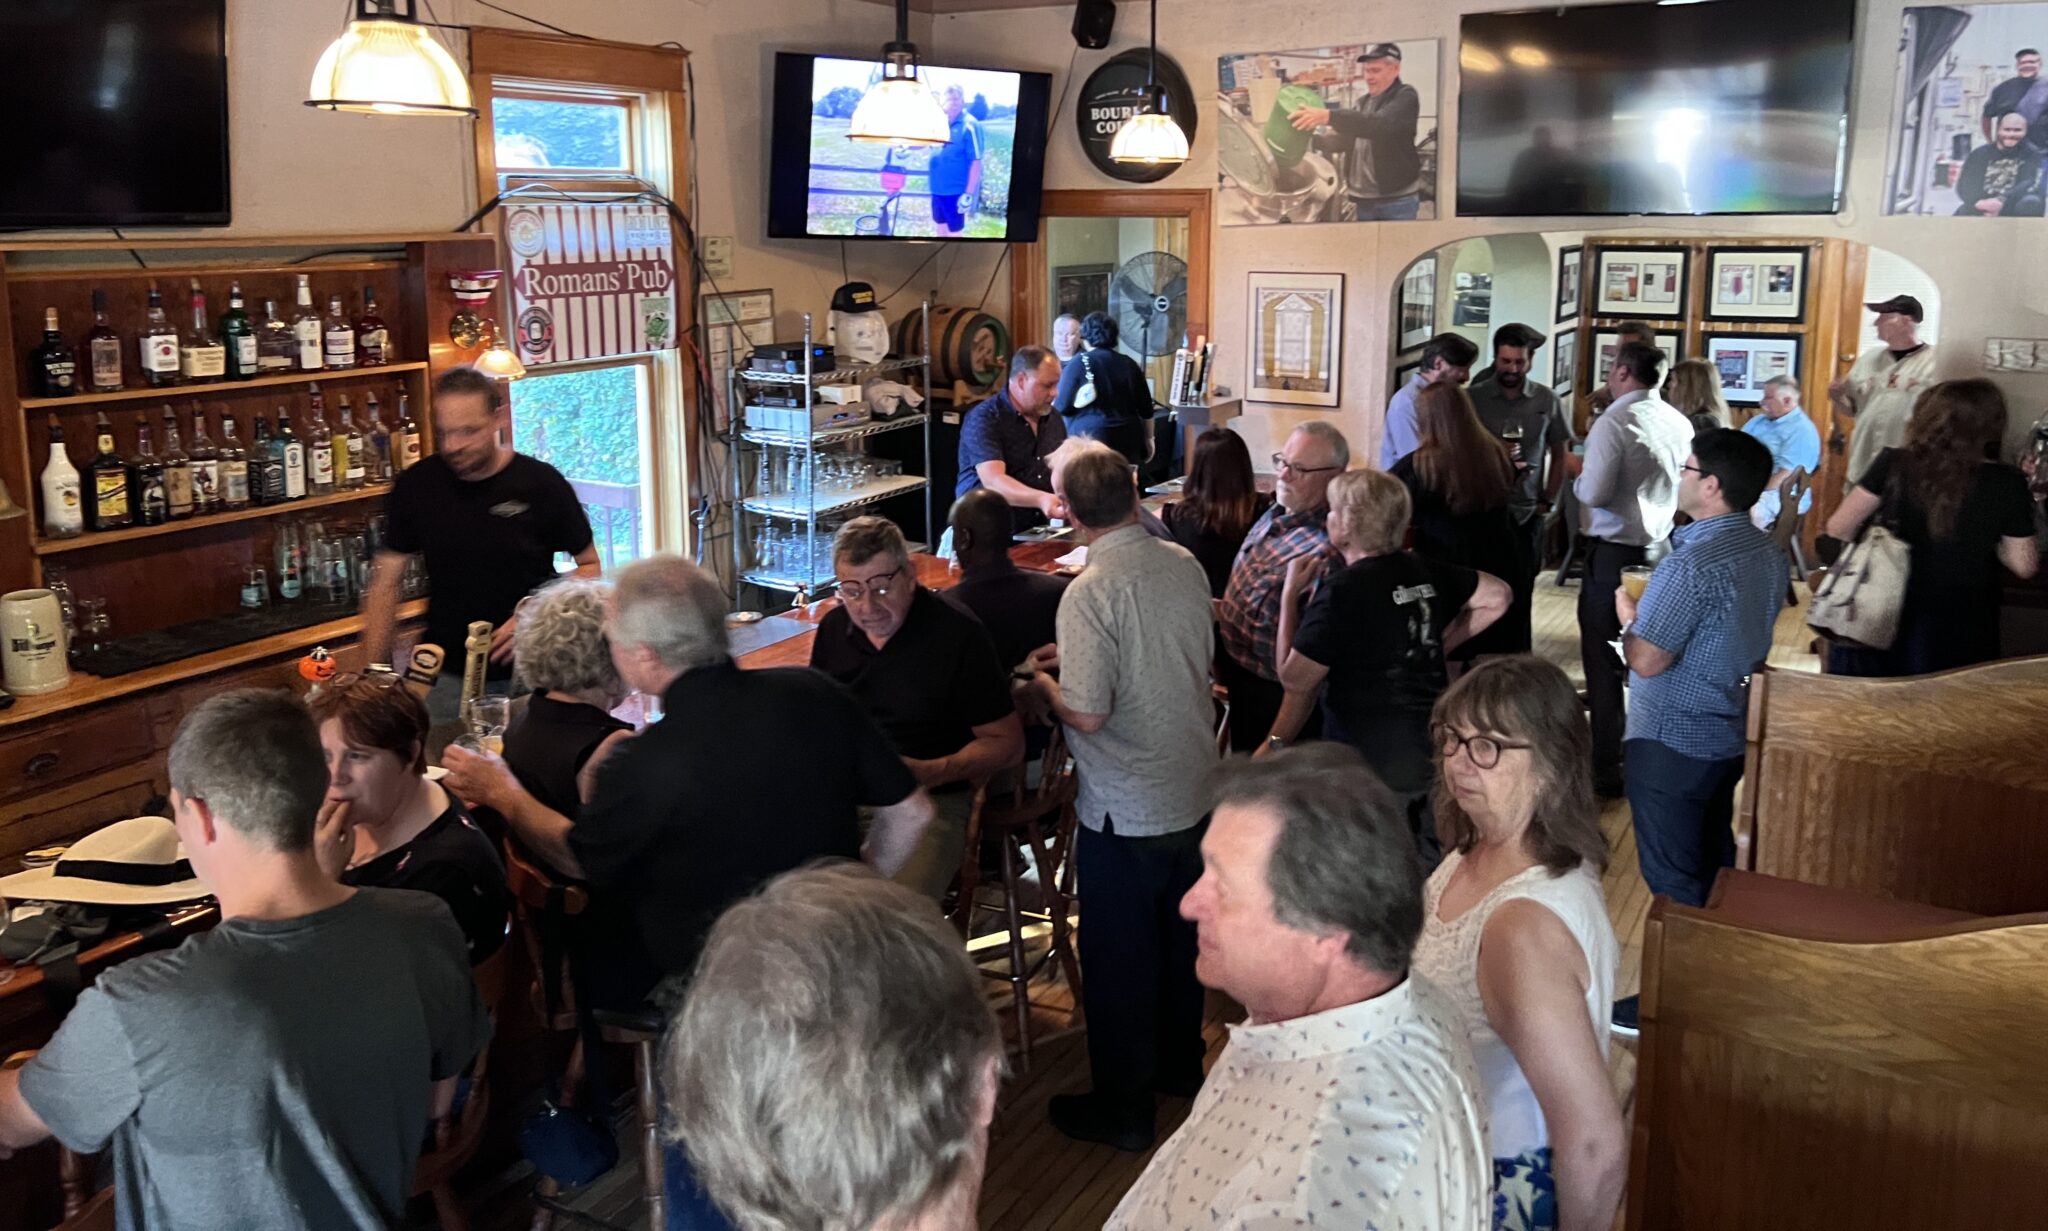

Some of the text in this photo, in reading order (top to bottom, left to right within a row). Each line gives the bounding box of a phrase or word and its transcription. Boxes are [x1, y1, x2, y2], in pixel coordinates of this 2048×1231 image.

[1091, 106, 1151, 120] BOUR
[522, 261, 667, 296] Romans' Pub
